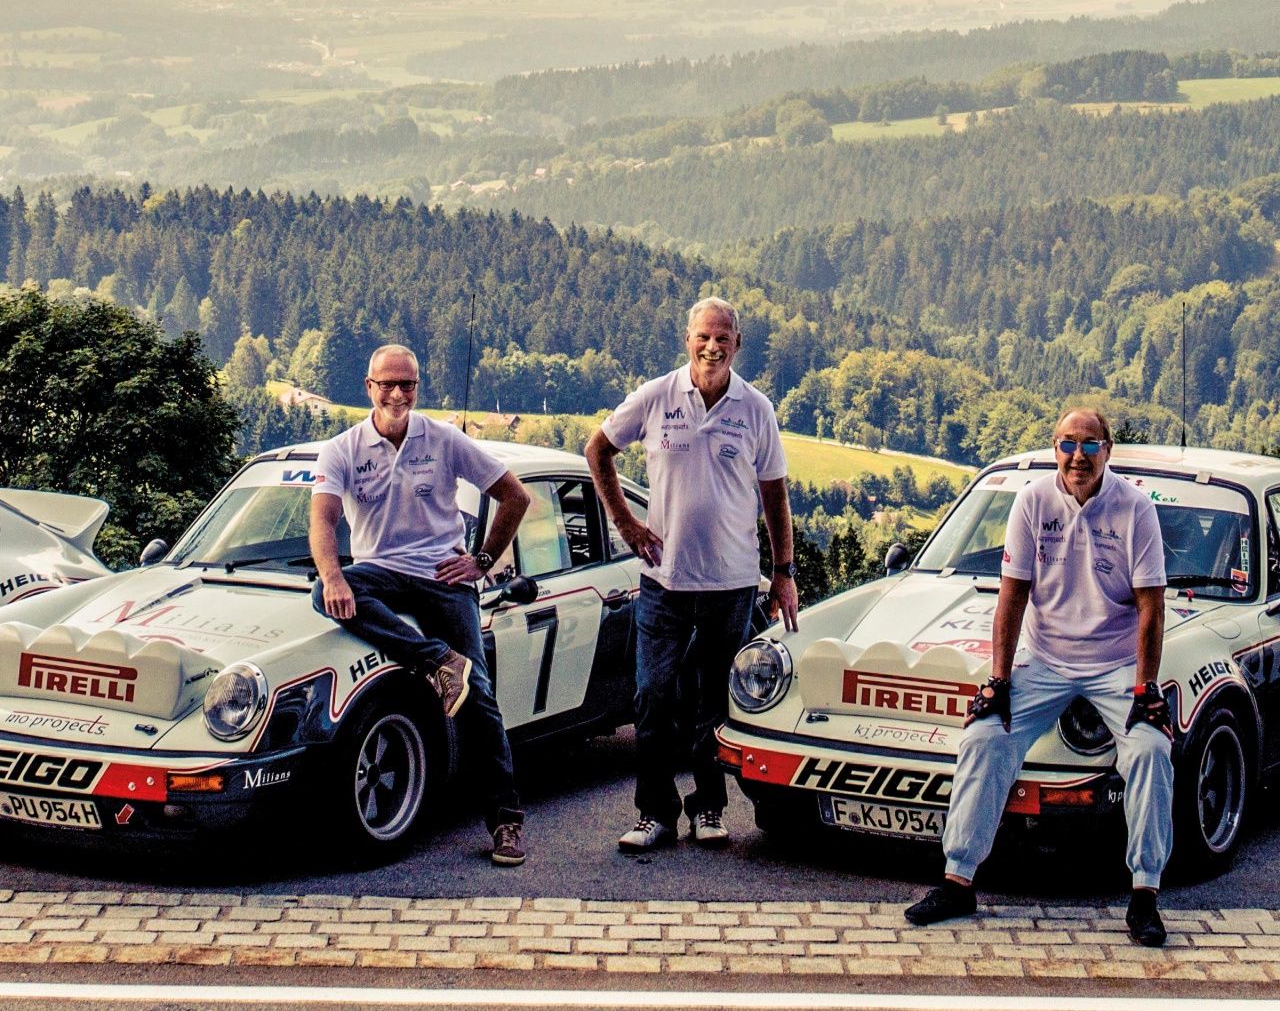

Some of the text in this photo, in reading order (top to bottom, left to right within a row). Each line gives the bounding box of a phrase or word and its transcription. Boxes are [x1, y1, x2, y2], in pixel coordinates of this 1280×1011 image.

[664, 407, 686, 419] wfv
[356, 459, 378, 474] wfv
[1042, 518, 1064, 531] wfv
[525, 605, 559, 714] 7
[18, 652, 137, 702] PIRELLI
[243, 769, 291, 789] Milians
